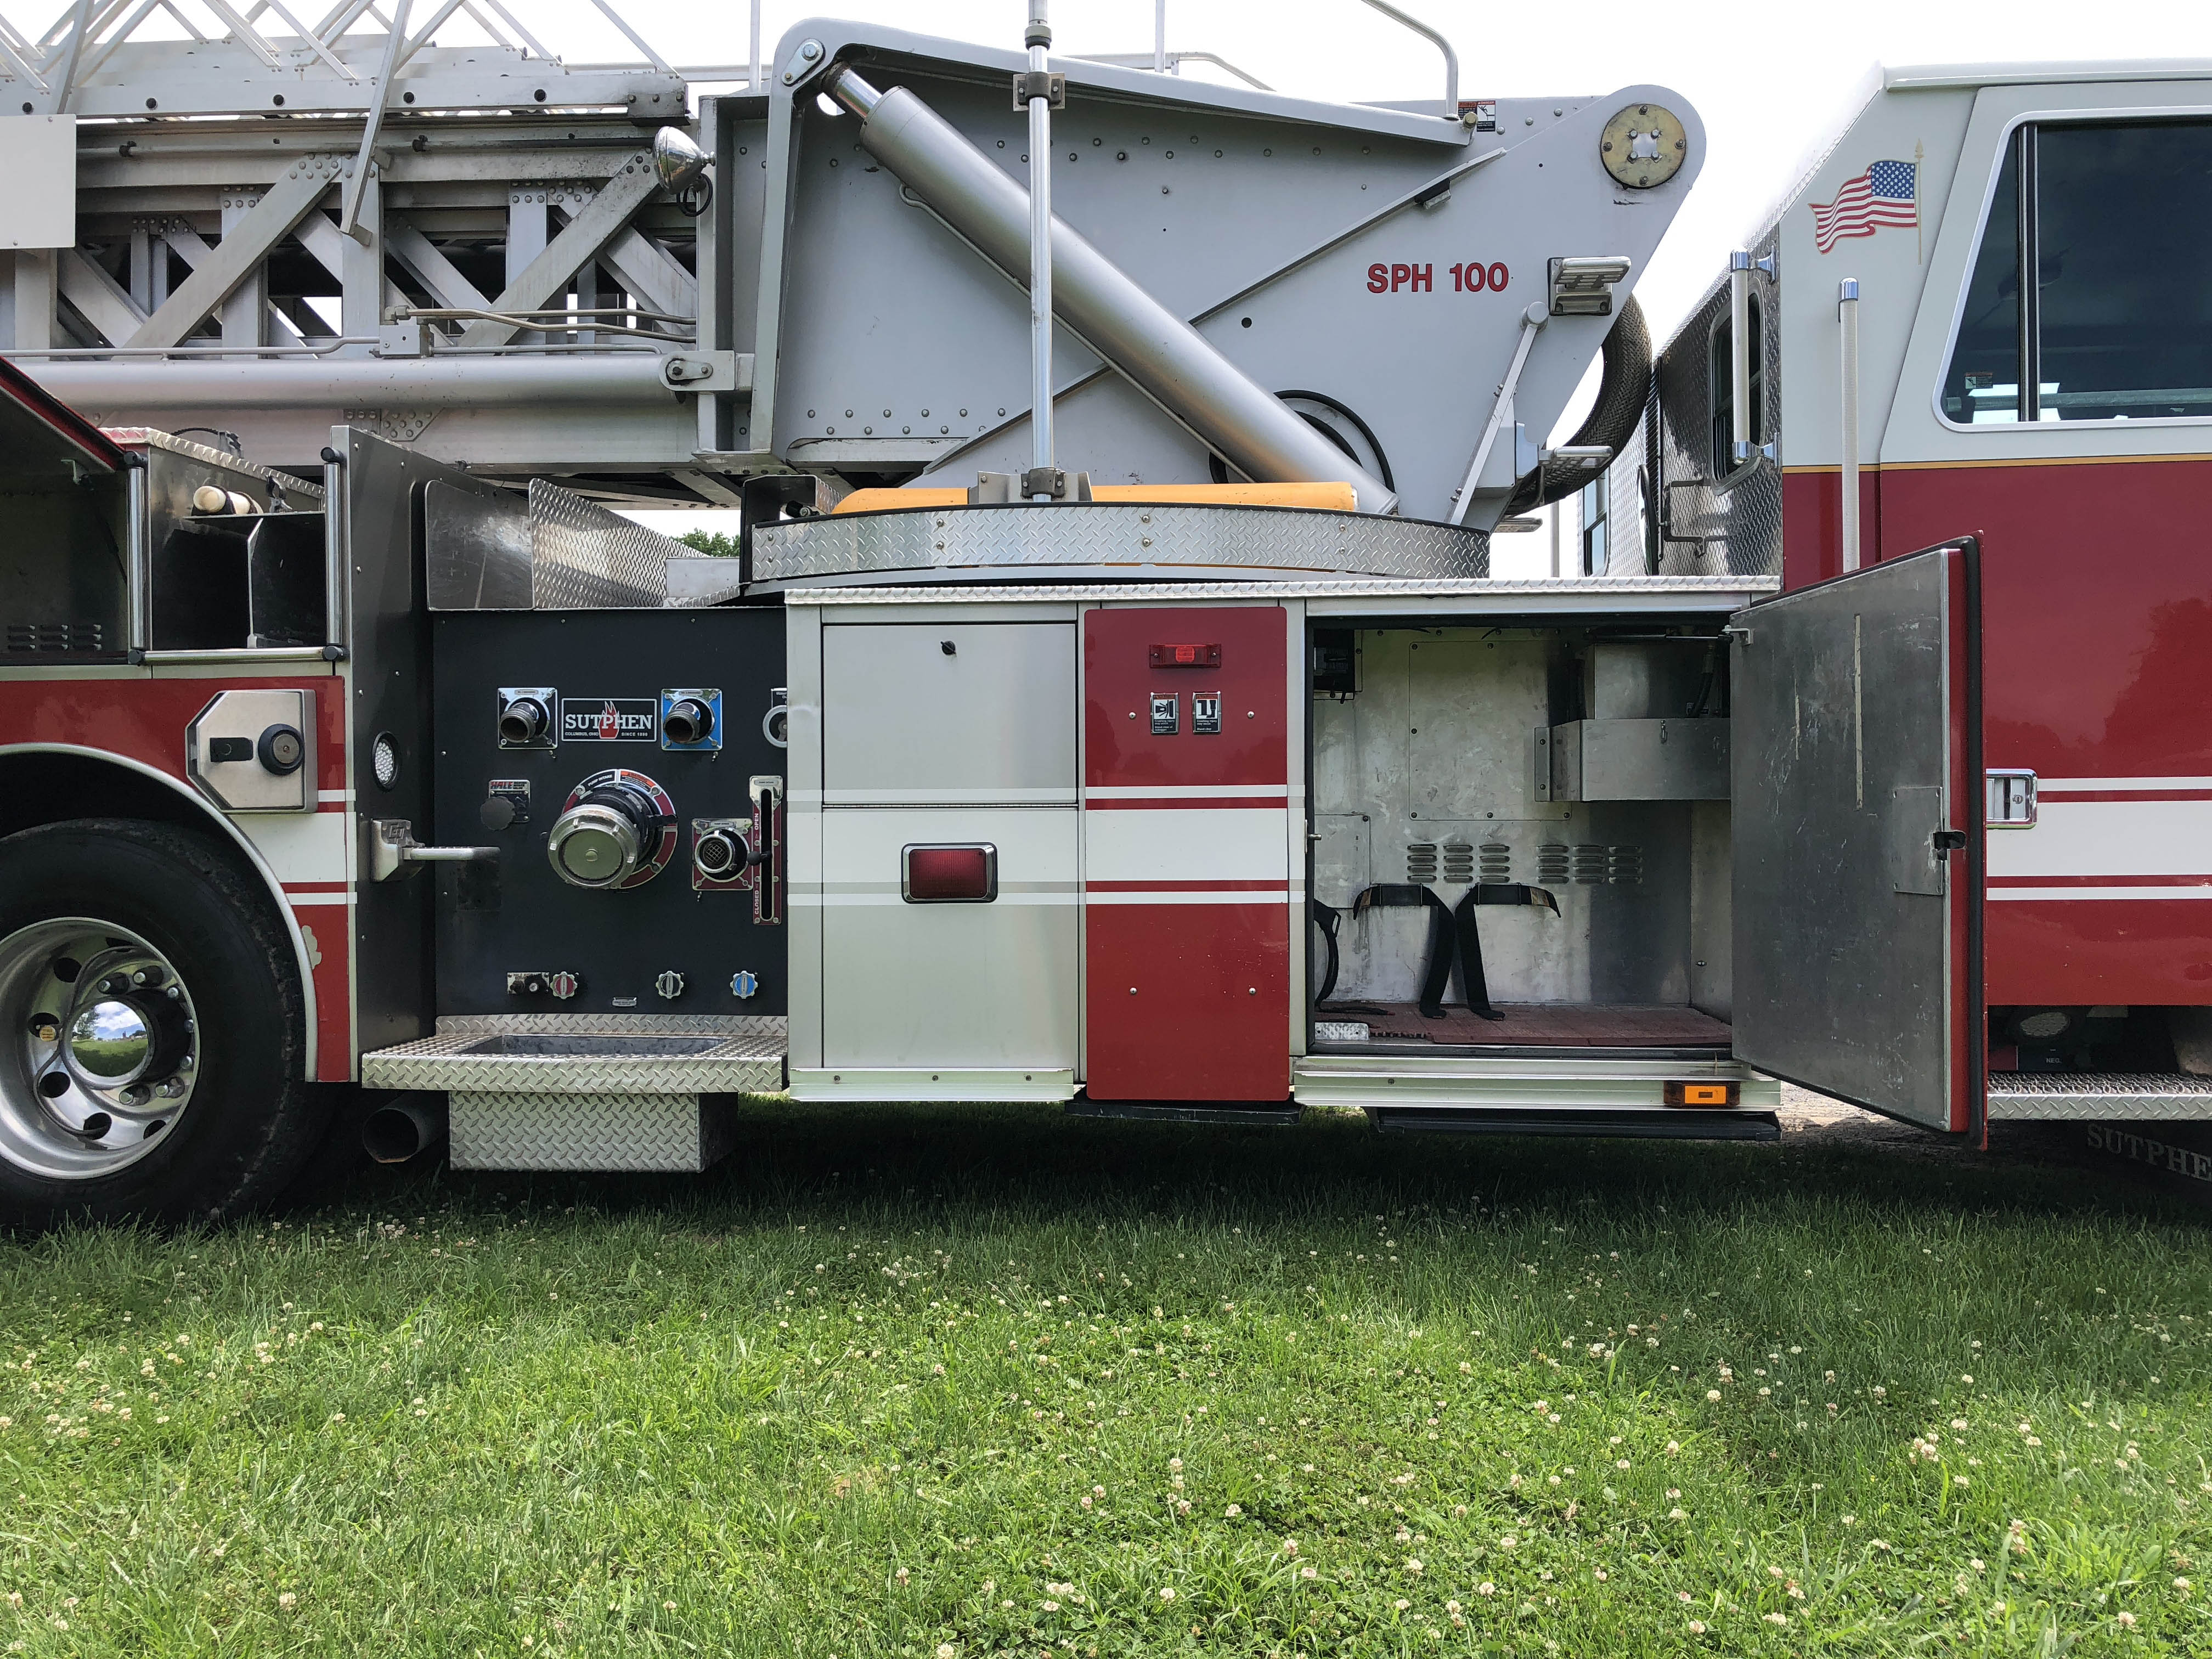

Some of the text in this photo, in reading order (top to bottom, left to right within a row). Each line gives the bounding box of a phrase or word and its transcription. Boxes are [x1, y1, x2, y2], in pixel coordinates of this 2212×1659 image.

[1367, 262, 1509, 294] SPH 100
[565, 714, 653, 729] SUTPHEN
[490, 781, 514, 789] HALE
